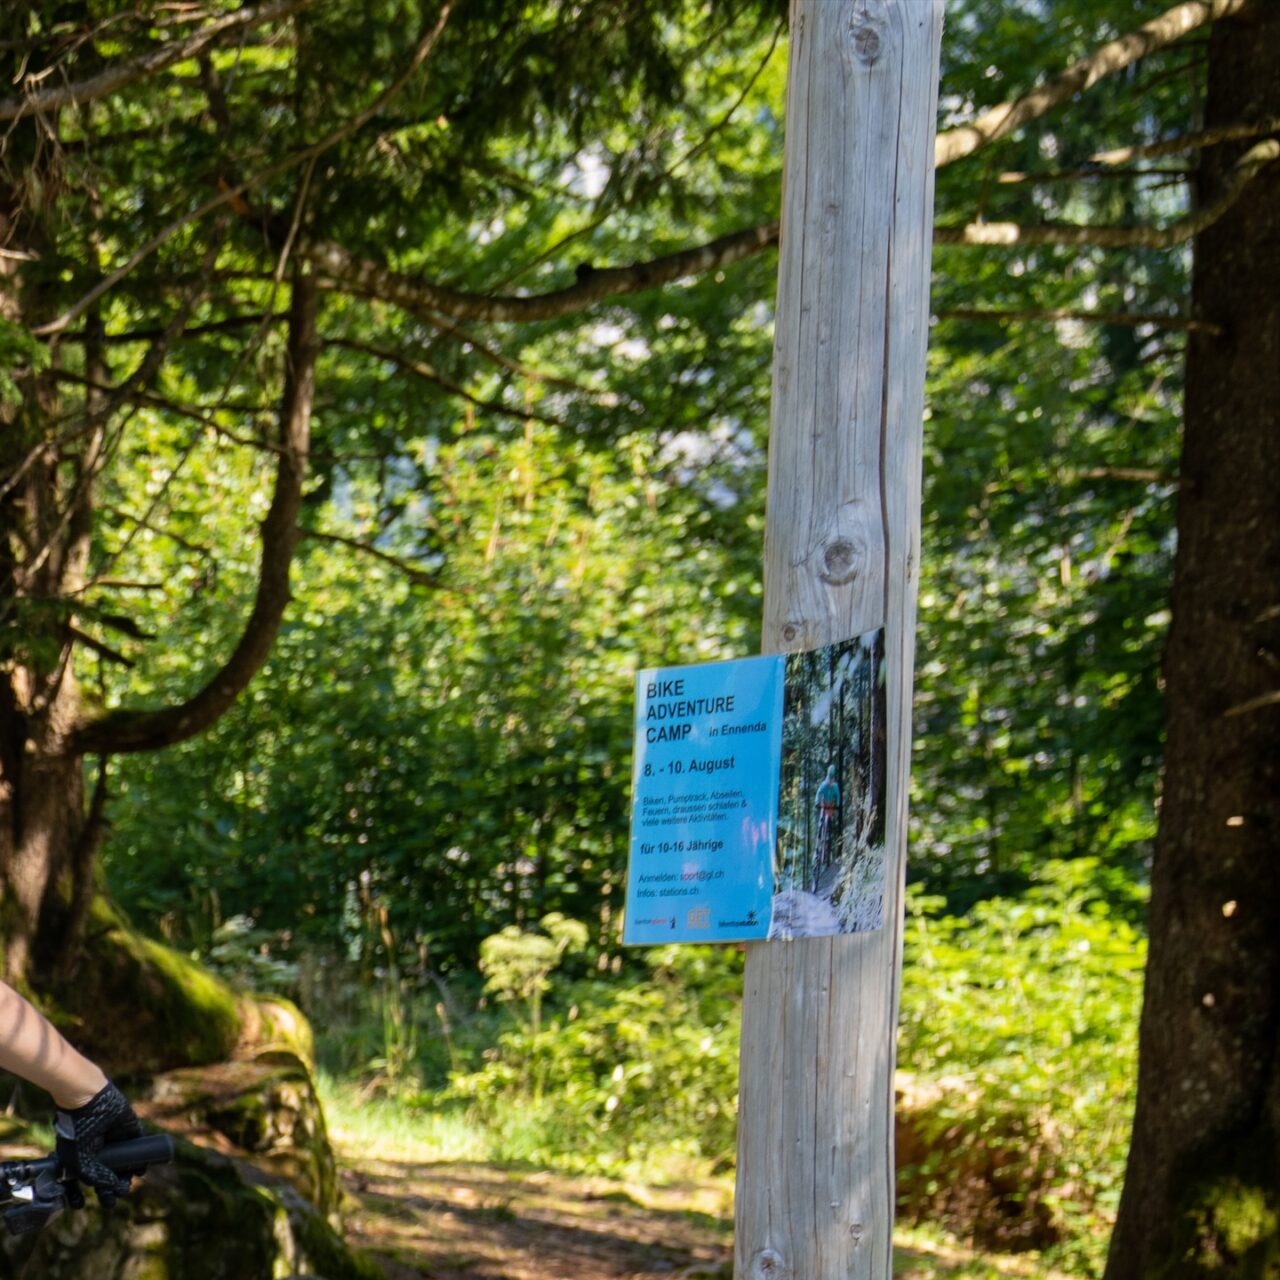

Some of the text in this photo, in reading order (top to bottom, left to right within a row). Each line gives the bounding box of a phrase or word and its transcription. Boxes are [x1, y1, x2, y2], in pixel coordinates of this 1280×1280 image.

[646, 679, 684, 699] BIKE
[646, 695, 735, 721] ADVENTURE
[646, 721, 767, 744] CAMP in Ennenda
[644, 763, 656, 777] 8.
[667, 760, 686, 775] 10.
[688, 755, 735, 774] August
[640, 839, 724, 855] für 10-16 Jährige
